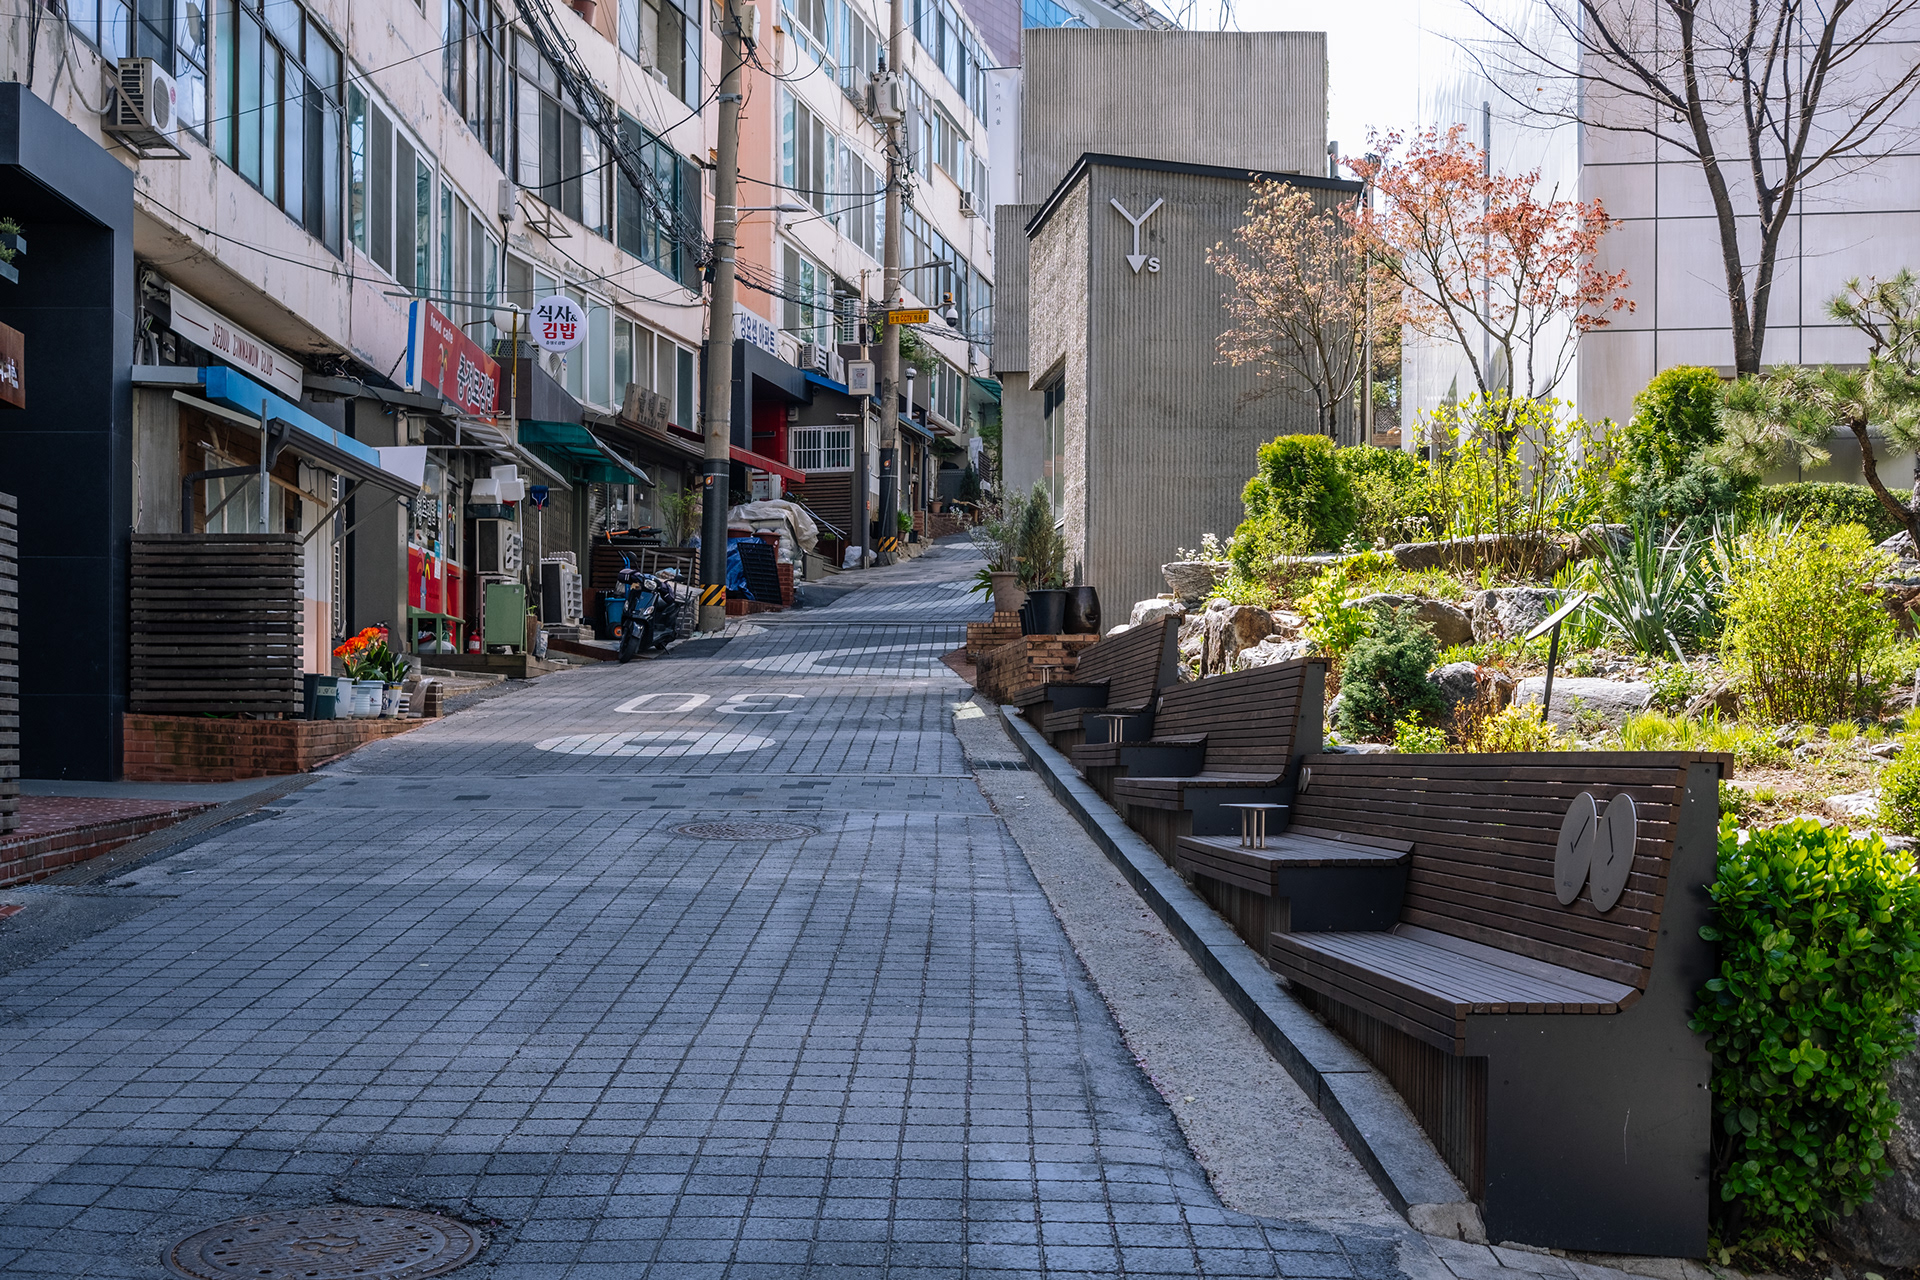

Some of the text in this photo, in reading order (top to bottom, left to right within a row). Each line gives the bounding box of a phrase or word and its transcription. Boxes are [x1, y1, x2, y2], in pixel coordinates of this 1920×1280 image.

[430, 312, 454, 345] food cafe
[542, 322, 577, 340] 김밥
[740, 311, 775, 354] 성요셉 아파트
[211, 322, 274, 377] SEOUL CINNAMON CLUB
[613, 692, 805, 716] 30
